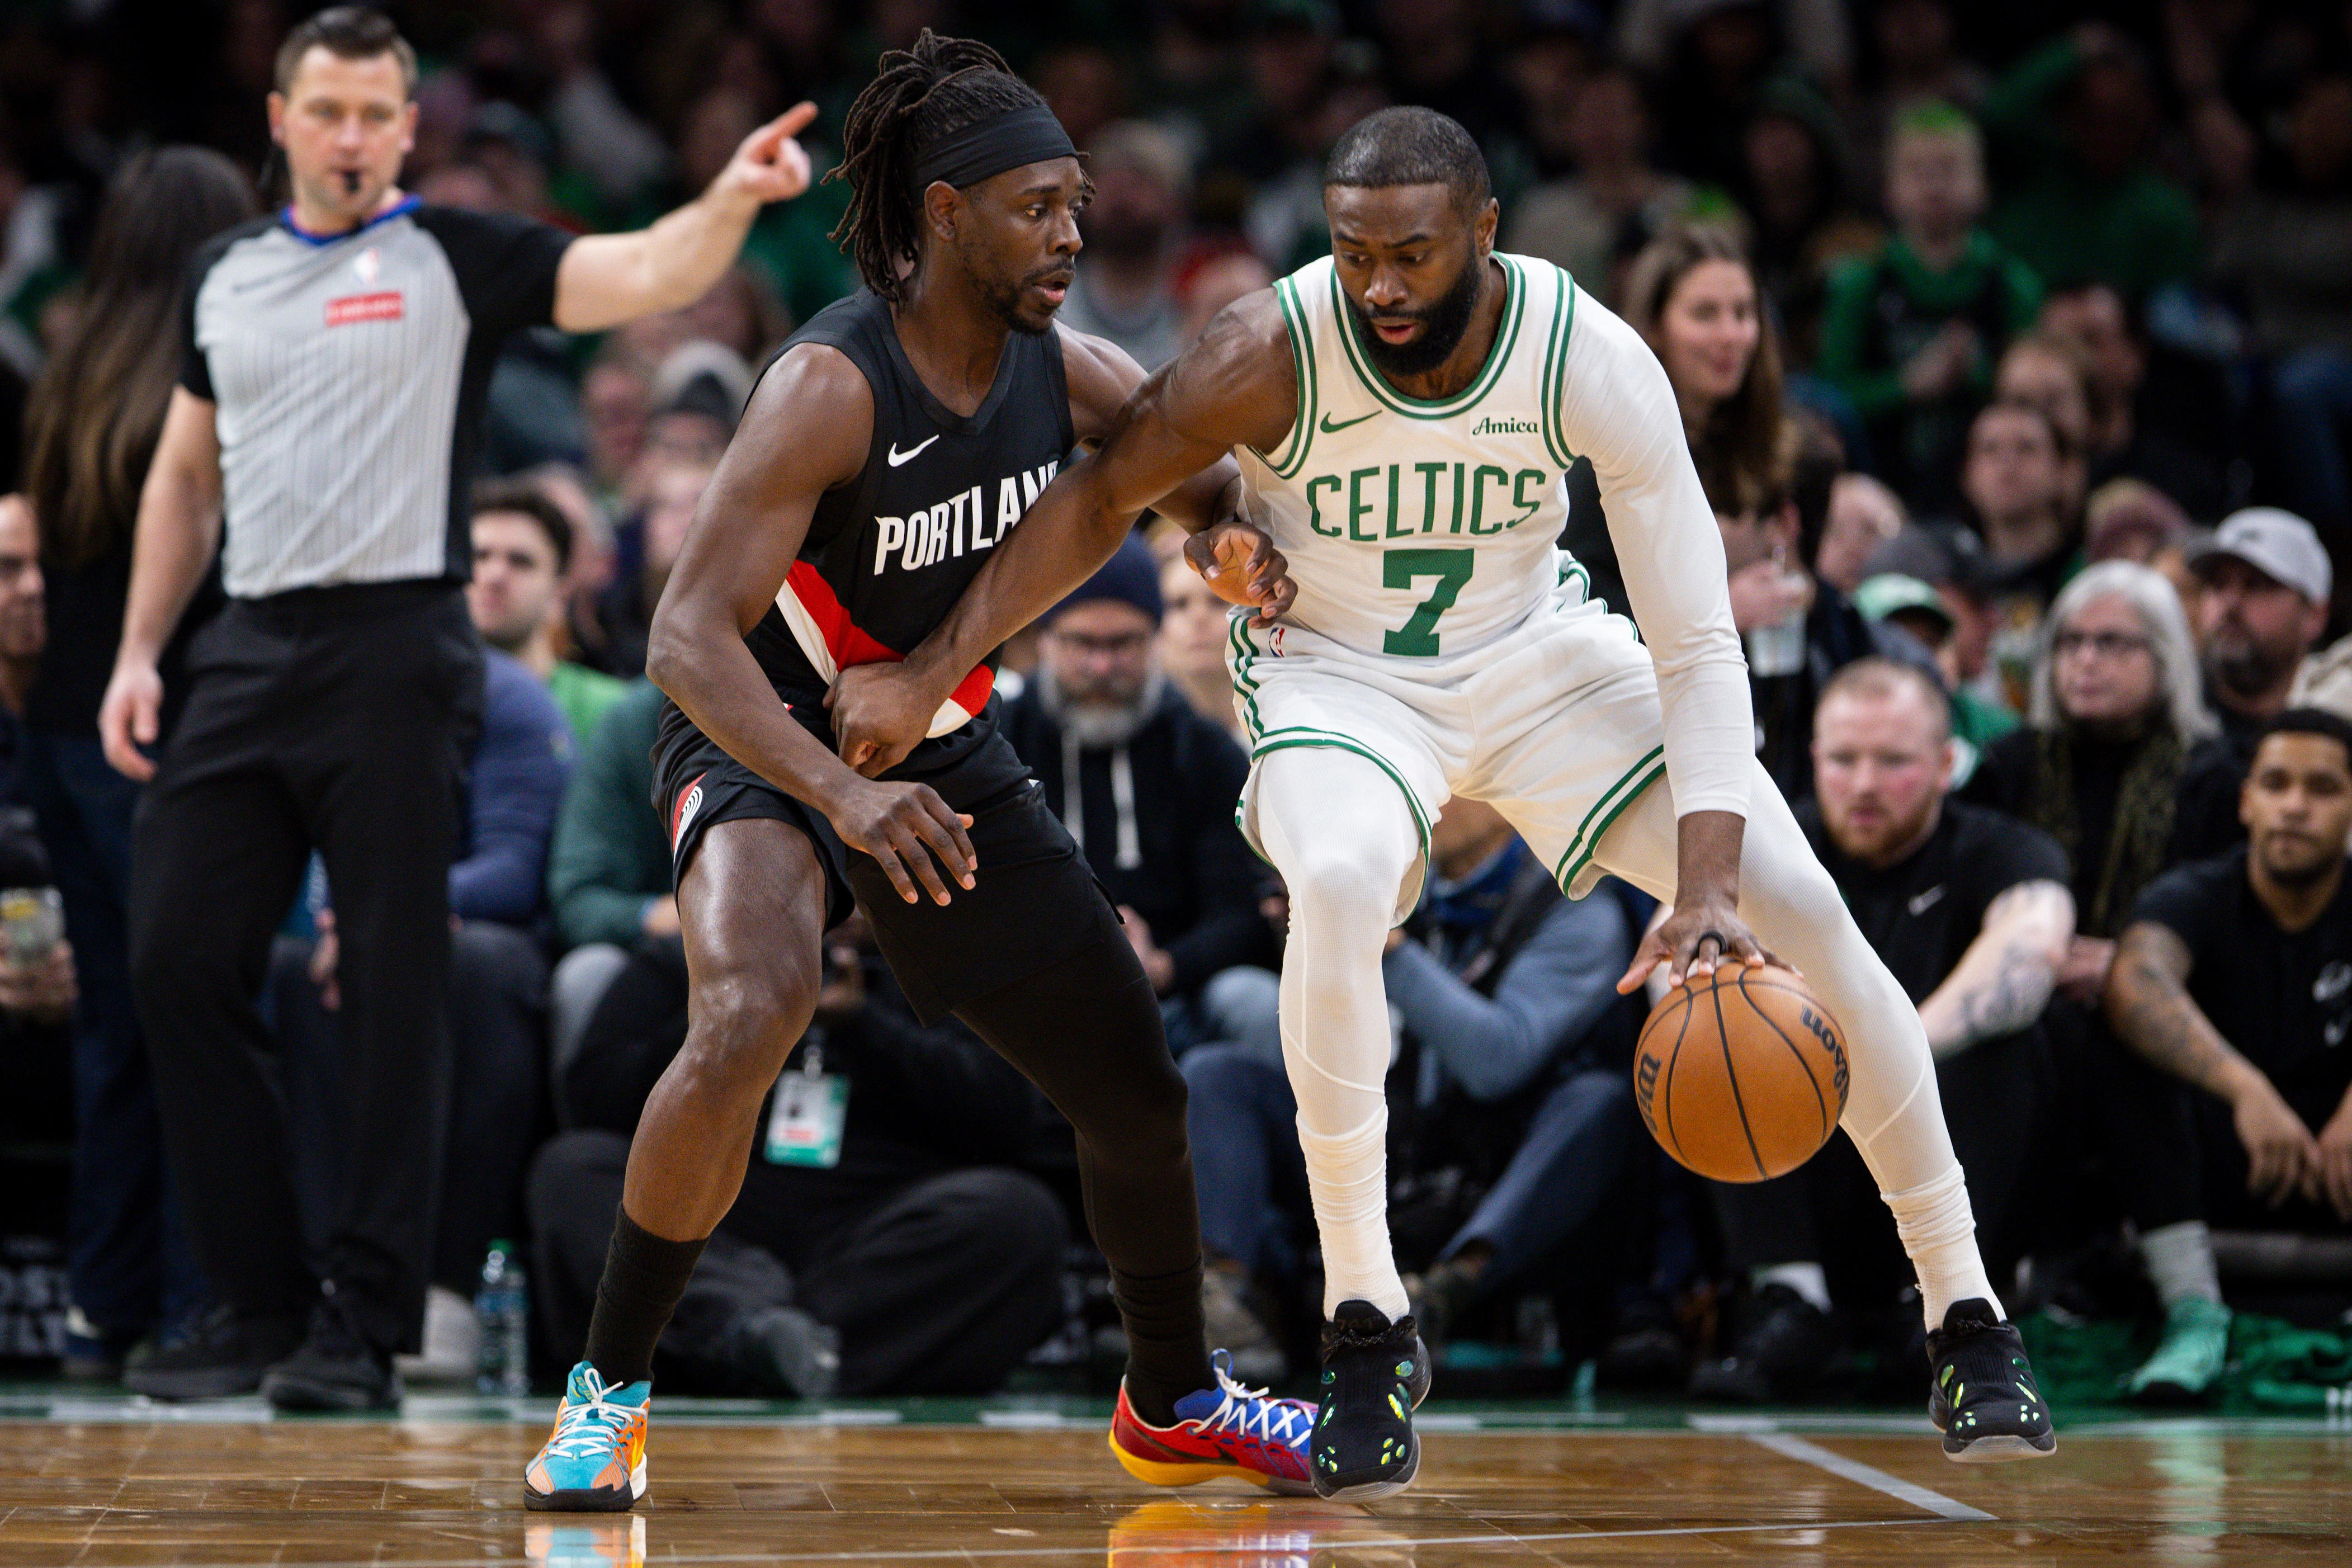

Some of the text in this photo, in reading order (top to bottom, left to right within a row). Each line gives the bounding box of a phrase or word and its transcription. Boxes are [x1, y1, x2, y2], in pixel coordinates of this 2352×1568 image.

[1472, 416, 1538, 436] Amica
[1306, 462, 1546, 541] CELTICS
[1382, 548, 1475, 657] 7
